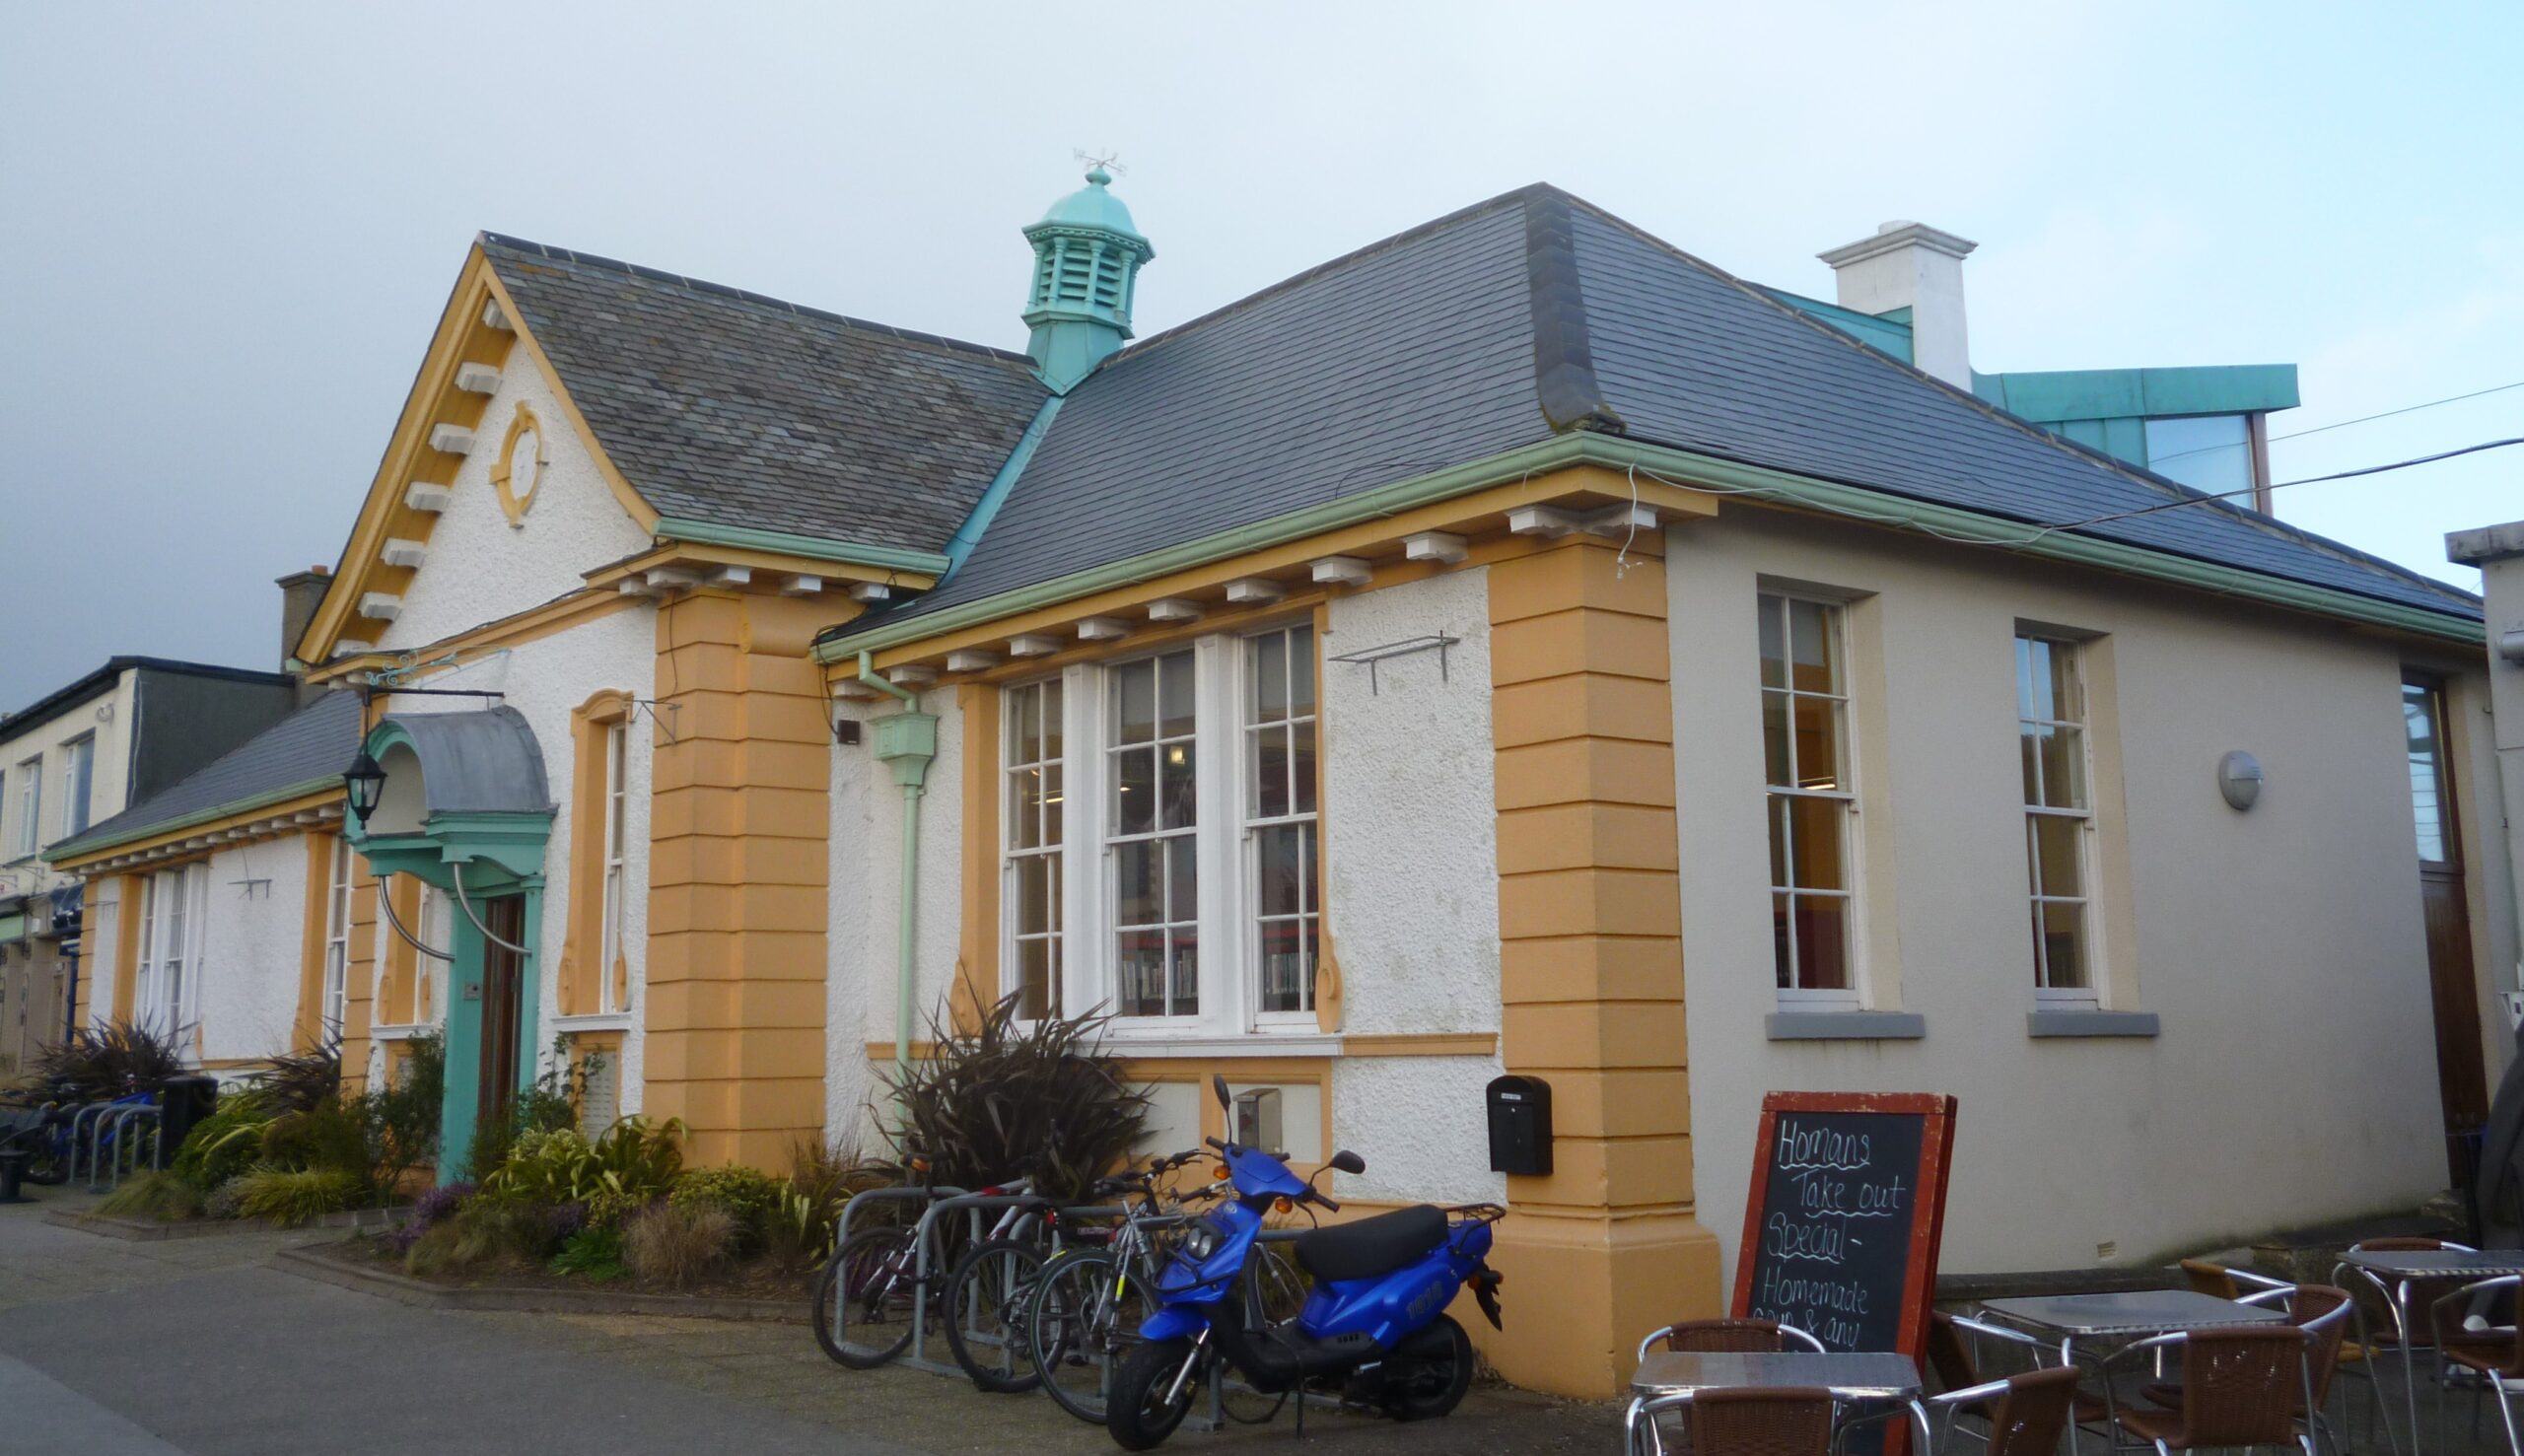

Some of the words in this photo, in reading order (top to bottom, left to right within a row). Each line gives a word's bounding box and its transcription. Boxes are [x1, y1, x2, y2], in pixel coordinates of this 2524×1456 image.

[1778, 1119, 1870, 1163] Homans
[1791, 1168, 1846, 1209] Take
[1858, 1175, 1907, 1209] out
[1763, 1266, 1869, 1314] Homemade
[1805, 1309, 1820, 1334] &
[1824, 1317, 1860, 1352] any
